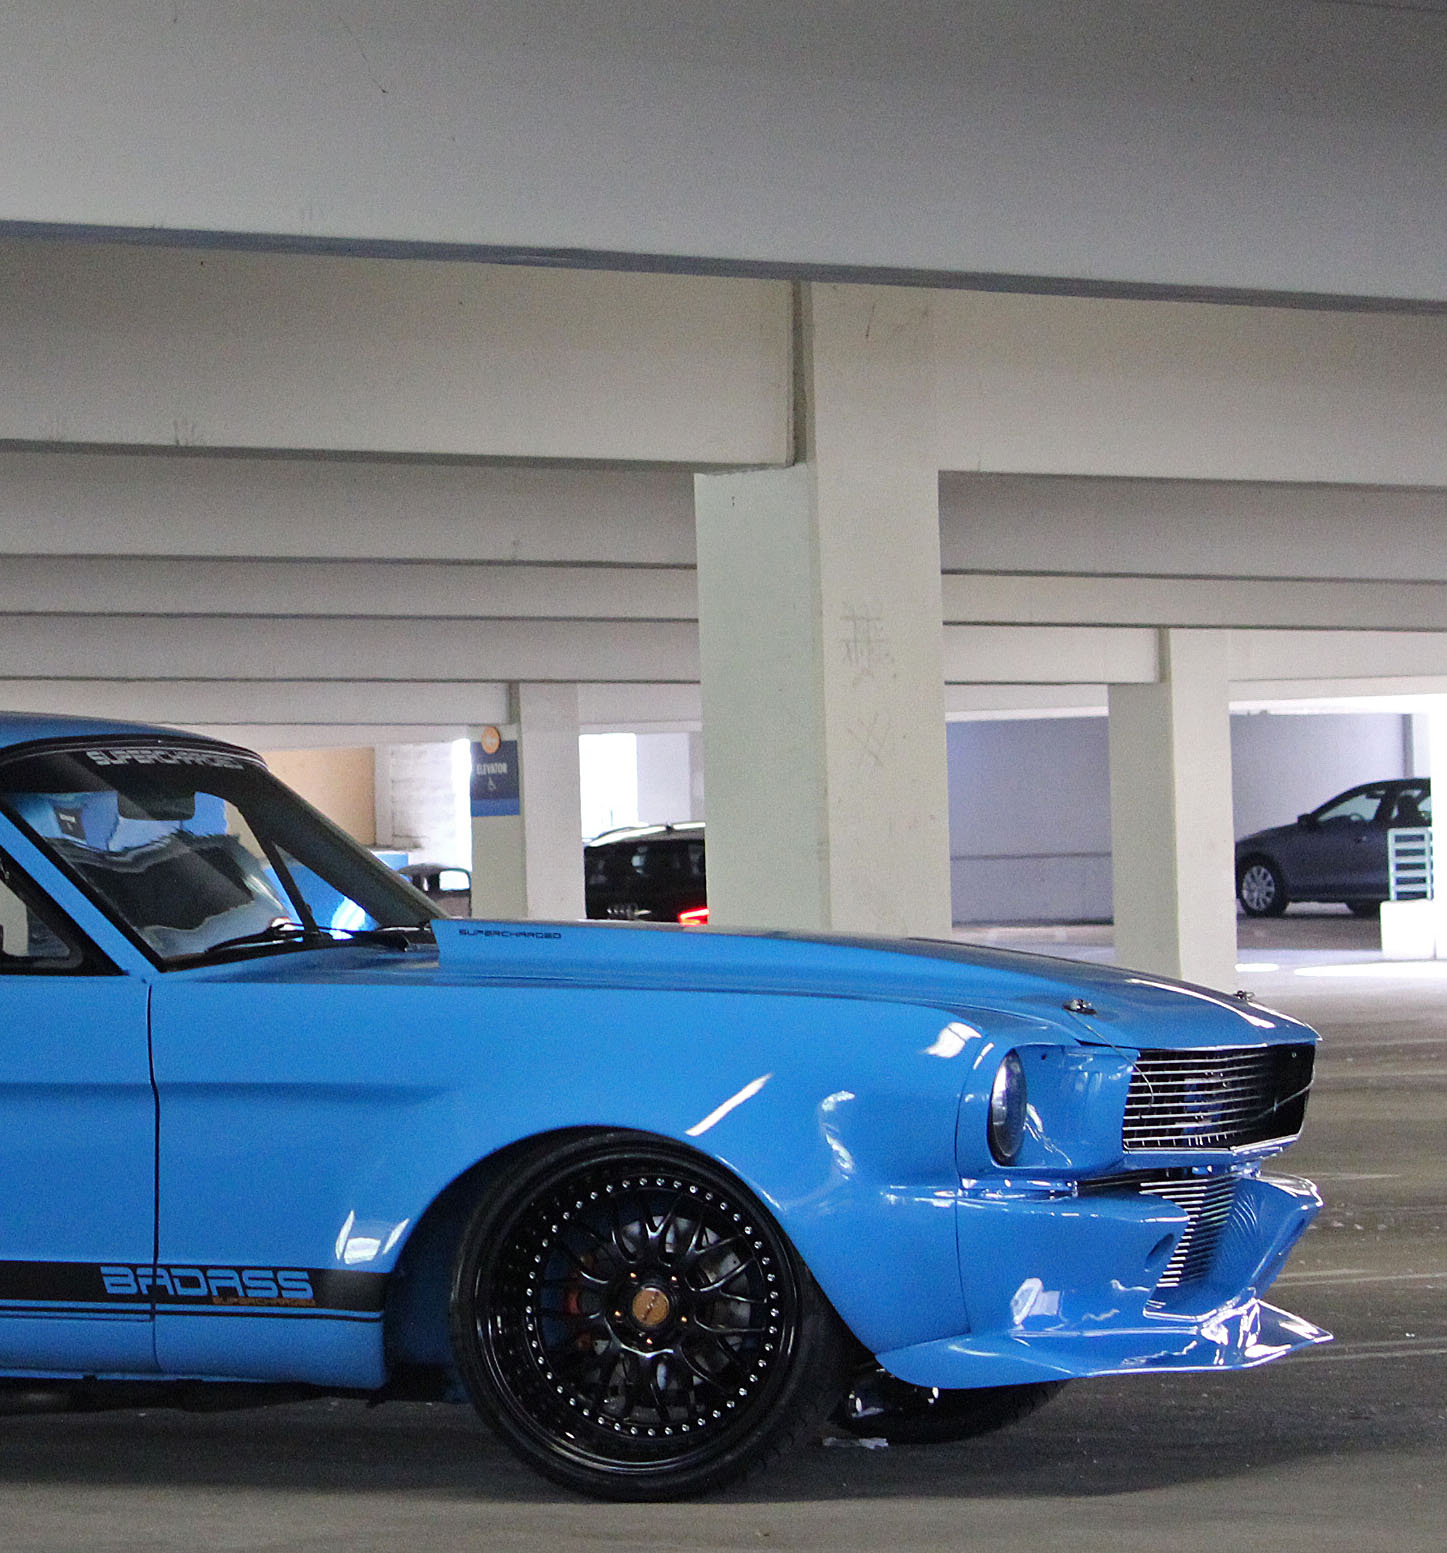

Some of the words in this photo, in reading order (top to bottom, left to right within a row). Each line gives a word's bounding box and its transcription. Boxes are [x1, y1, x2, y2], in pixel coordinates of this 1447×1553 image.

[476, 762, 508, 776] ELEVATOR
[458, 928, 562, 939] SUPERCHARGED
[100, 1266, 314, 1300] BADASS
